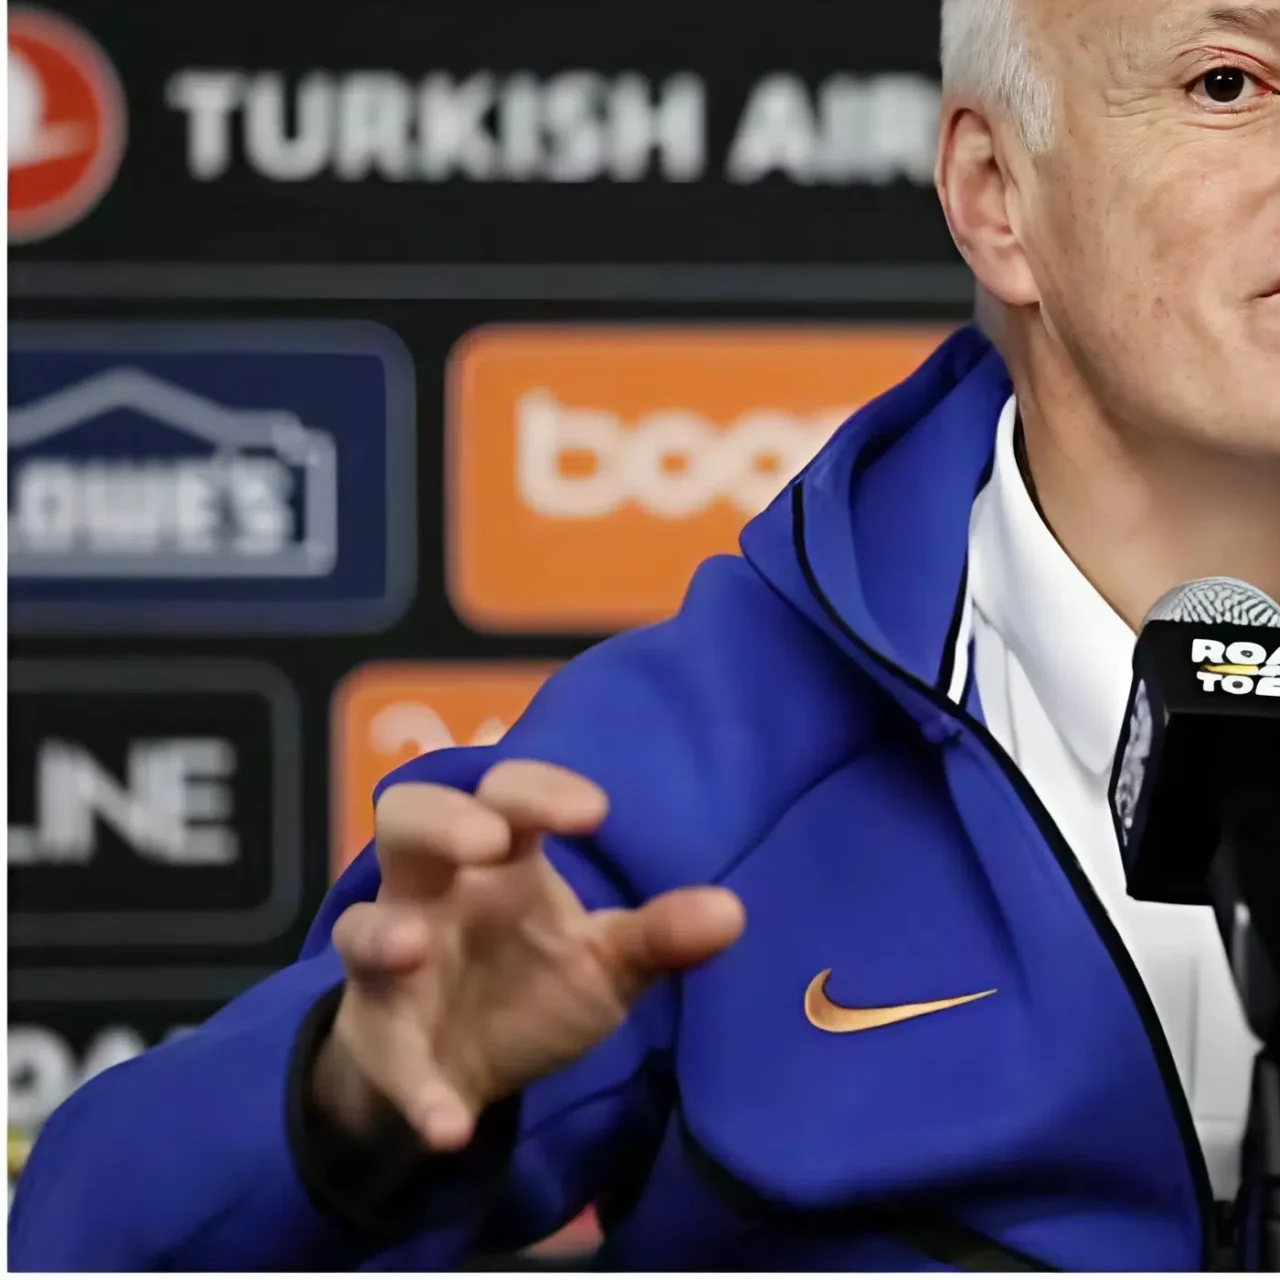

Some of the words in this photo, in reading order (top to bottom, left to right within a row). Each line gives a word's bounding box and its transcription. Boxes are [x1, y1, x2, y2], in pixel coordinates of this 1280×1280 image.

[165, 70, 707, 184] TURKISH
[8, 456, 298, 558] OWE'S
[1196, 670, 1254, 695] TO
